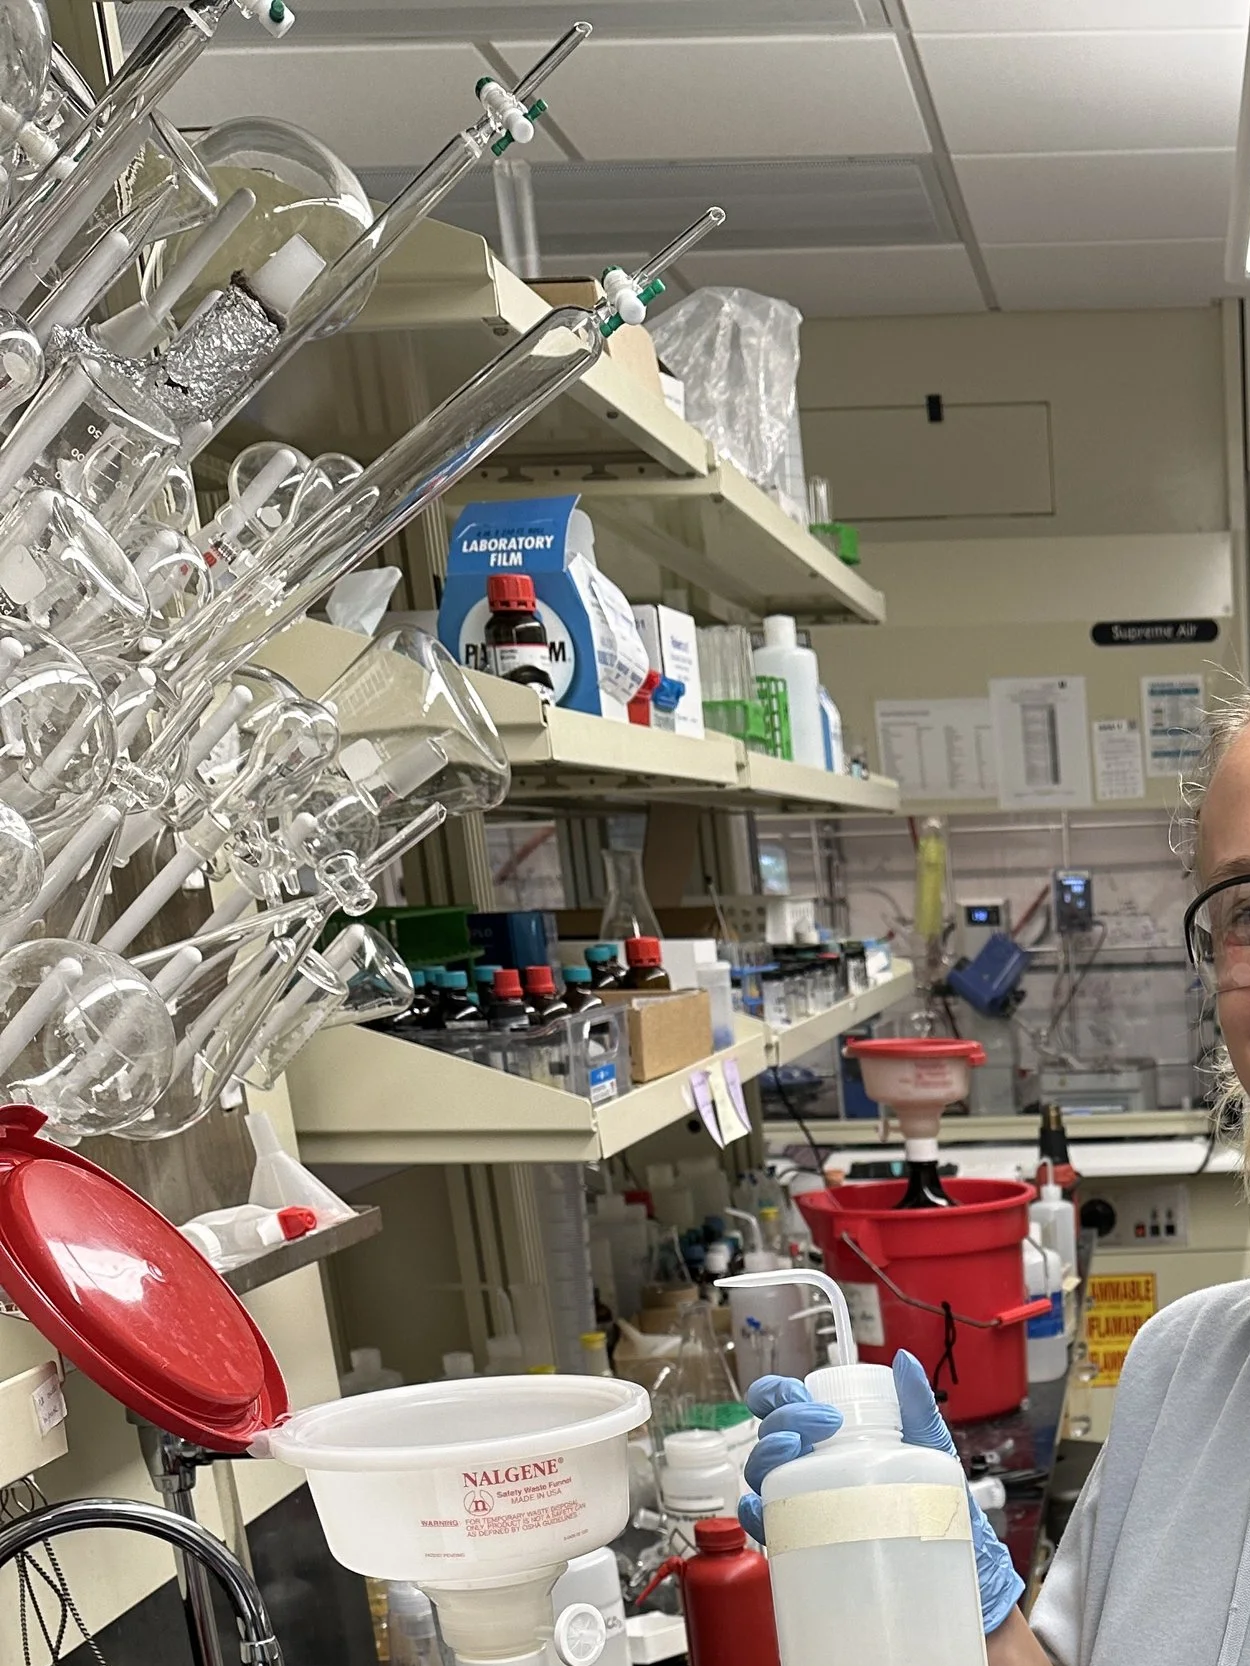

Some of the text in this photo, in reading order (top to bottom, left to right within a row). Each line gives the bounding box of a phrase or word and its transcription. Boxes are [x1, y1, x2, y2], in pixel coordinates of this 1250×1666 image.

[462, 535, 554, 553] LABORATORY
[490, 551, 523, 567] FILM
[1112, 623, 1198, 641] Supreme Air
[462, 1458, 559, 1488] NALGENE
[496, 1476, 572, 1499] Safety Waste Funnel
[511, 1488, 562, 1505] MADE IN USA
[420, 1519, 459, 1528] WARNING
[465, 1518, 480, 1526] FOR
[483, 1512, 526, 1524] TEMPORARY
[479, 1527, 509, 1537] DEFINED
